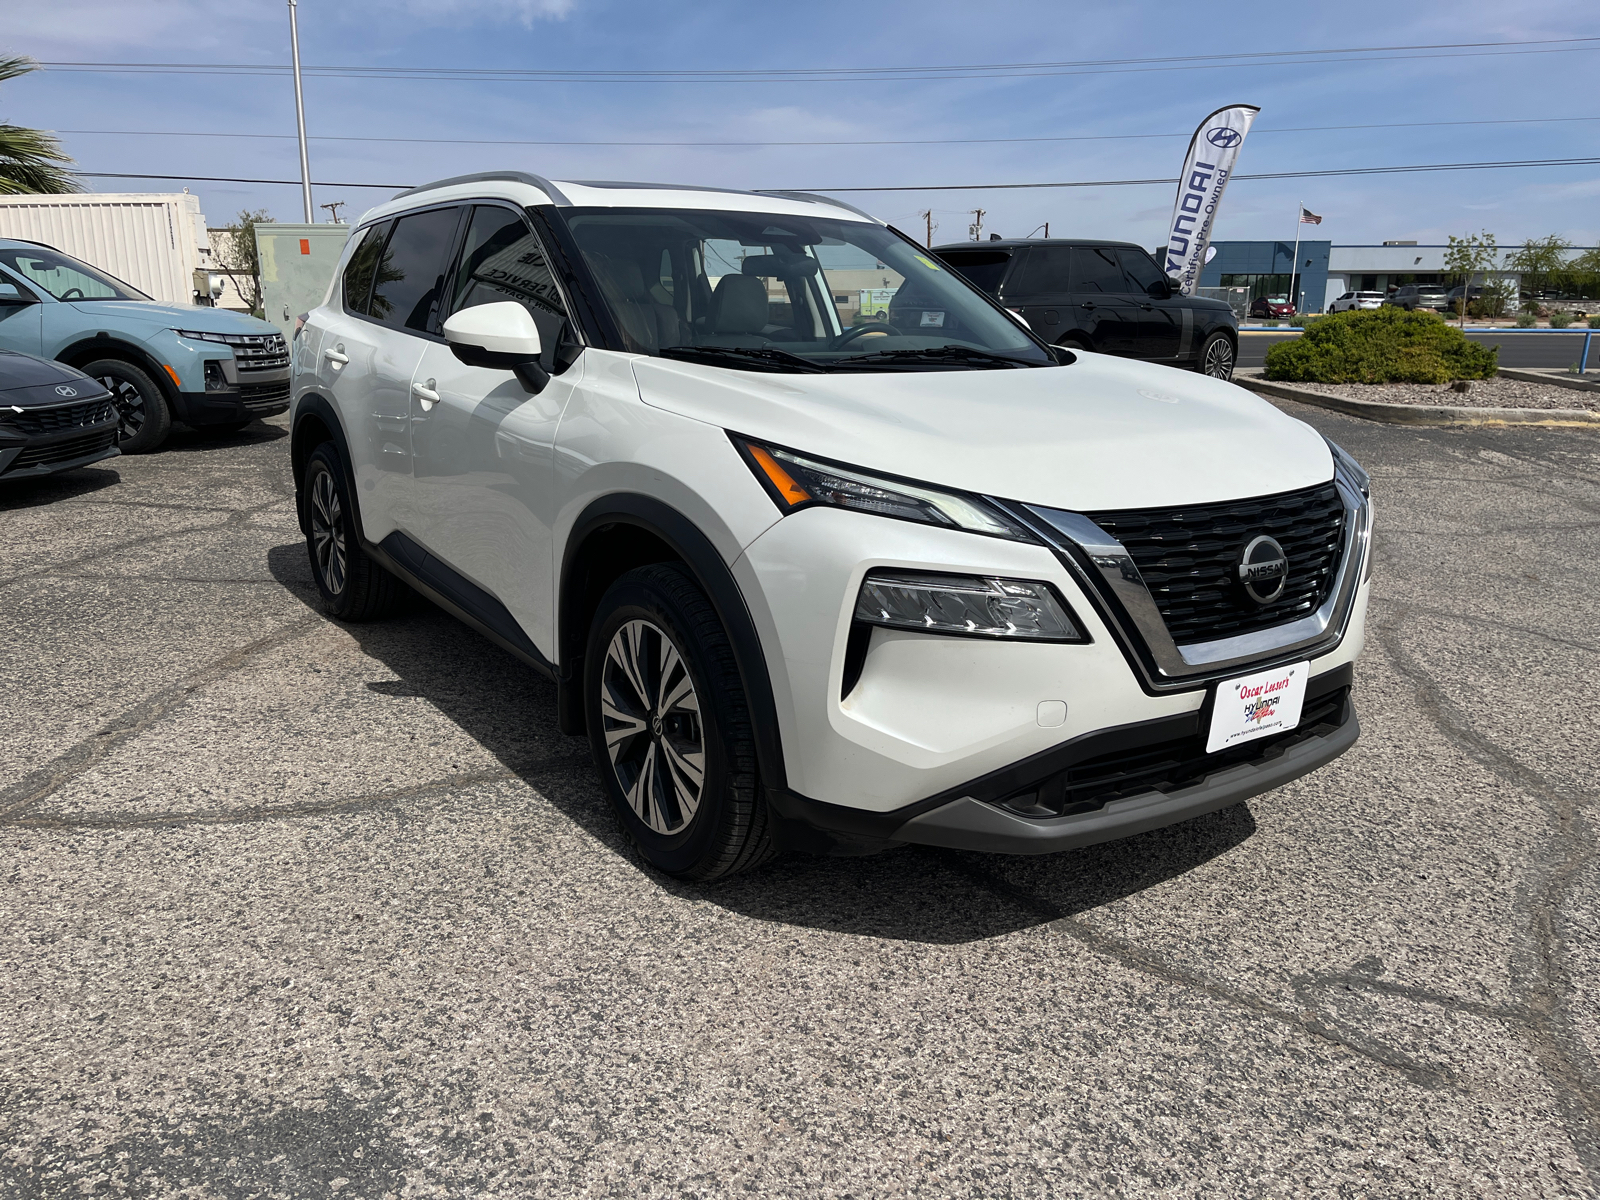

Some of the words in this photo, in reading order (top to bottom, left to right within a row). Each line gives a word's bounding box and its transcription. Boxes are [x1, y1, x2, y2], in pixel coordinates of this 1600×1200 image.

[1166, 161, 1215, 272] YUNDAI
[1181, 243, 1203, 297] Certified
[1196, 169, 1228, 241] Pre-Owned
[1247, 562, 1285, 577] NISSAN
[1240, 685, 1264, 700] Oscar
[1264, 676, 1290, 695] Leeser's
[1244, 695, 1281, 713] HYUNDAI
